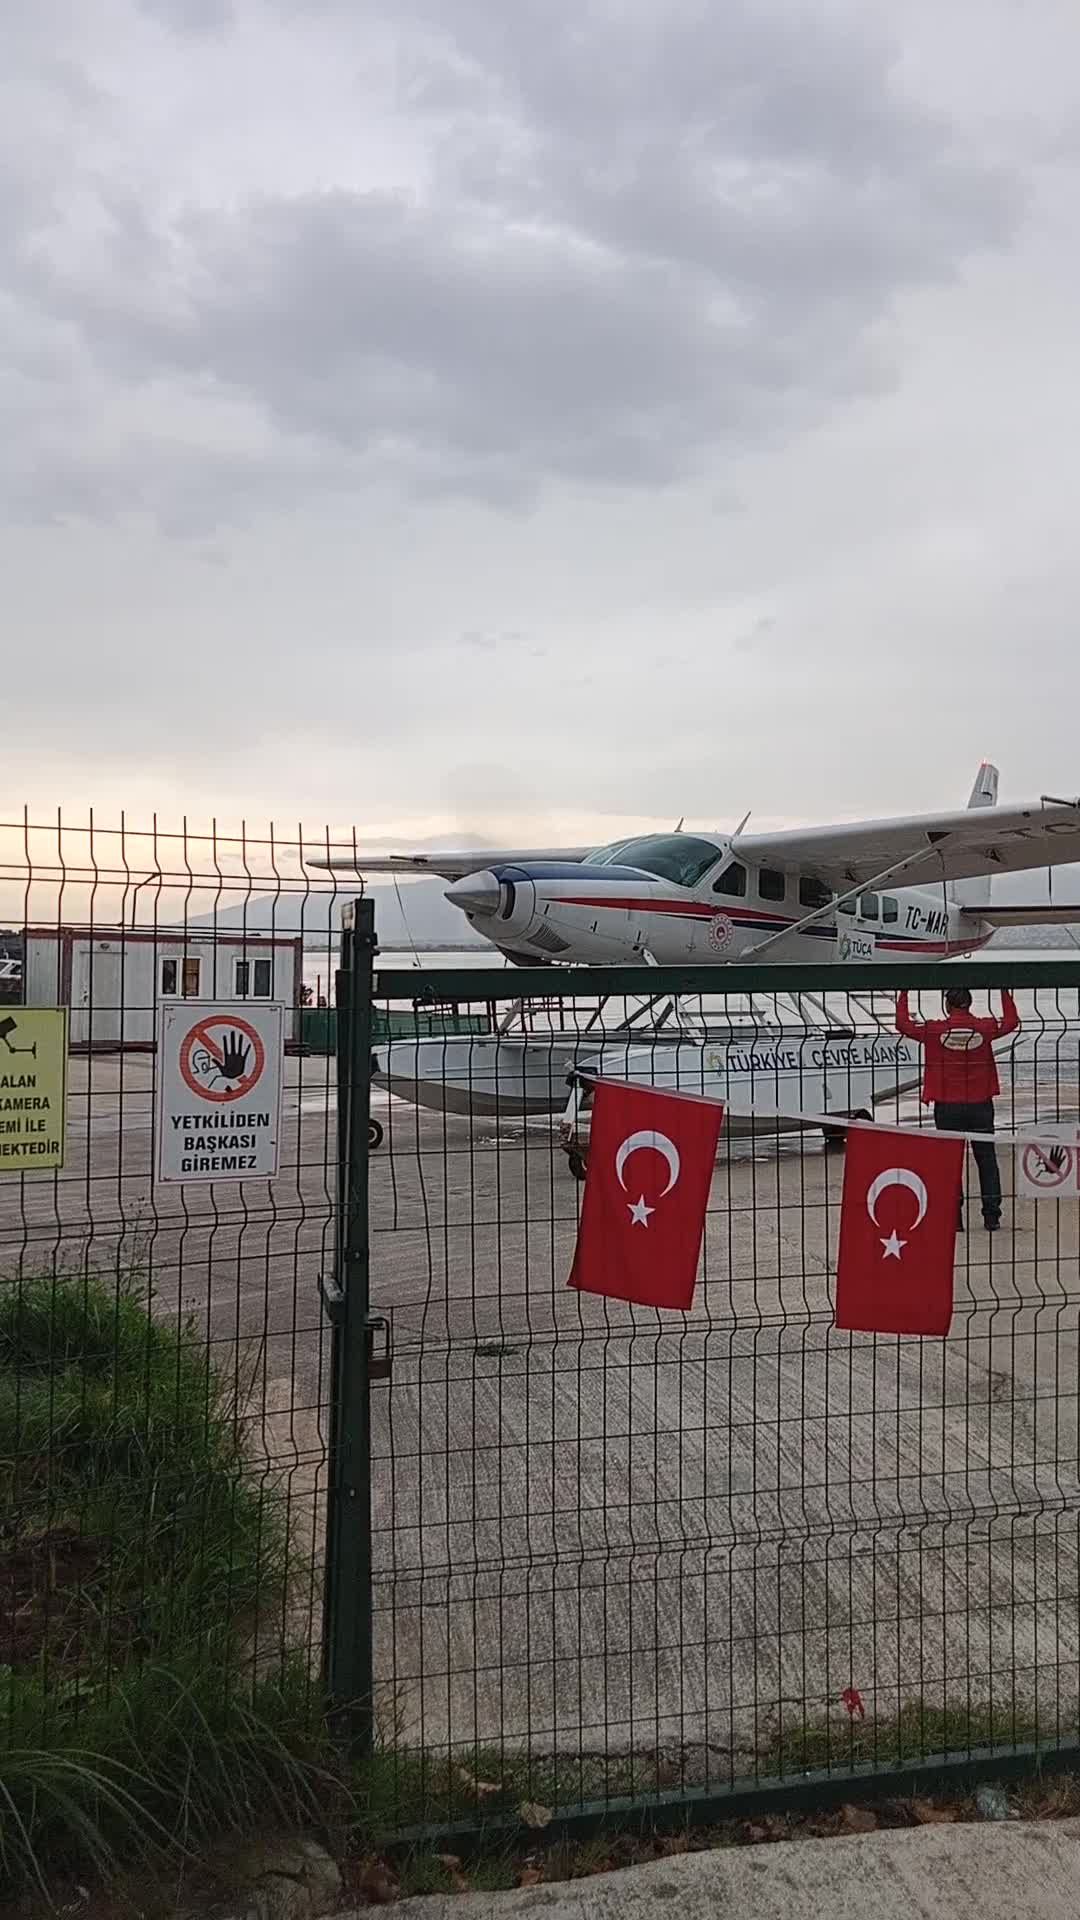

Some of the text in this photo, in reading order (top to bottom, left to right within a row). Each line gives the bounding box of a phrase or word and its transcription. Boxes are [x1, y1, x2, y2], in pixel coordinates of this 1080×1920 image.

[728, 1048, 798, 1072] TÜRKİYE
[863, 1045, 912, 1064] AJANSI
[0, 1075, 36, 1088] ALAN
[25, 1117, 46, 1132] İLE
[171, 1111, 270, 1130] YETKİLİDEN
[0, 1139, 59, 1156] EKTEDİR
[184, 1135, 256, 1153] BAŞKASI
[181, 1154, 257, 1172] GİREMEZ
